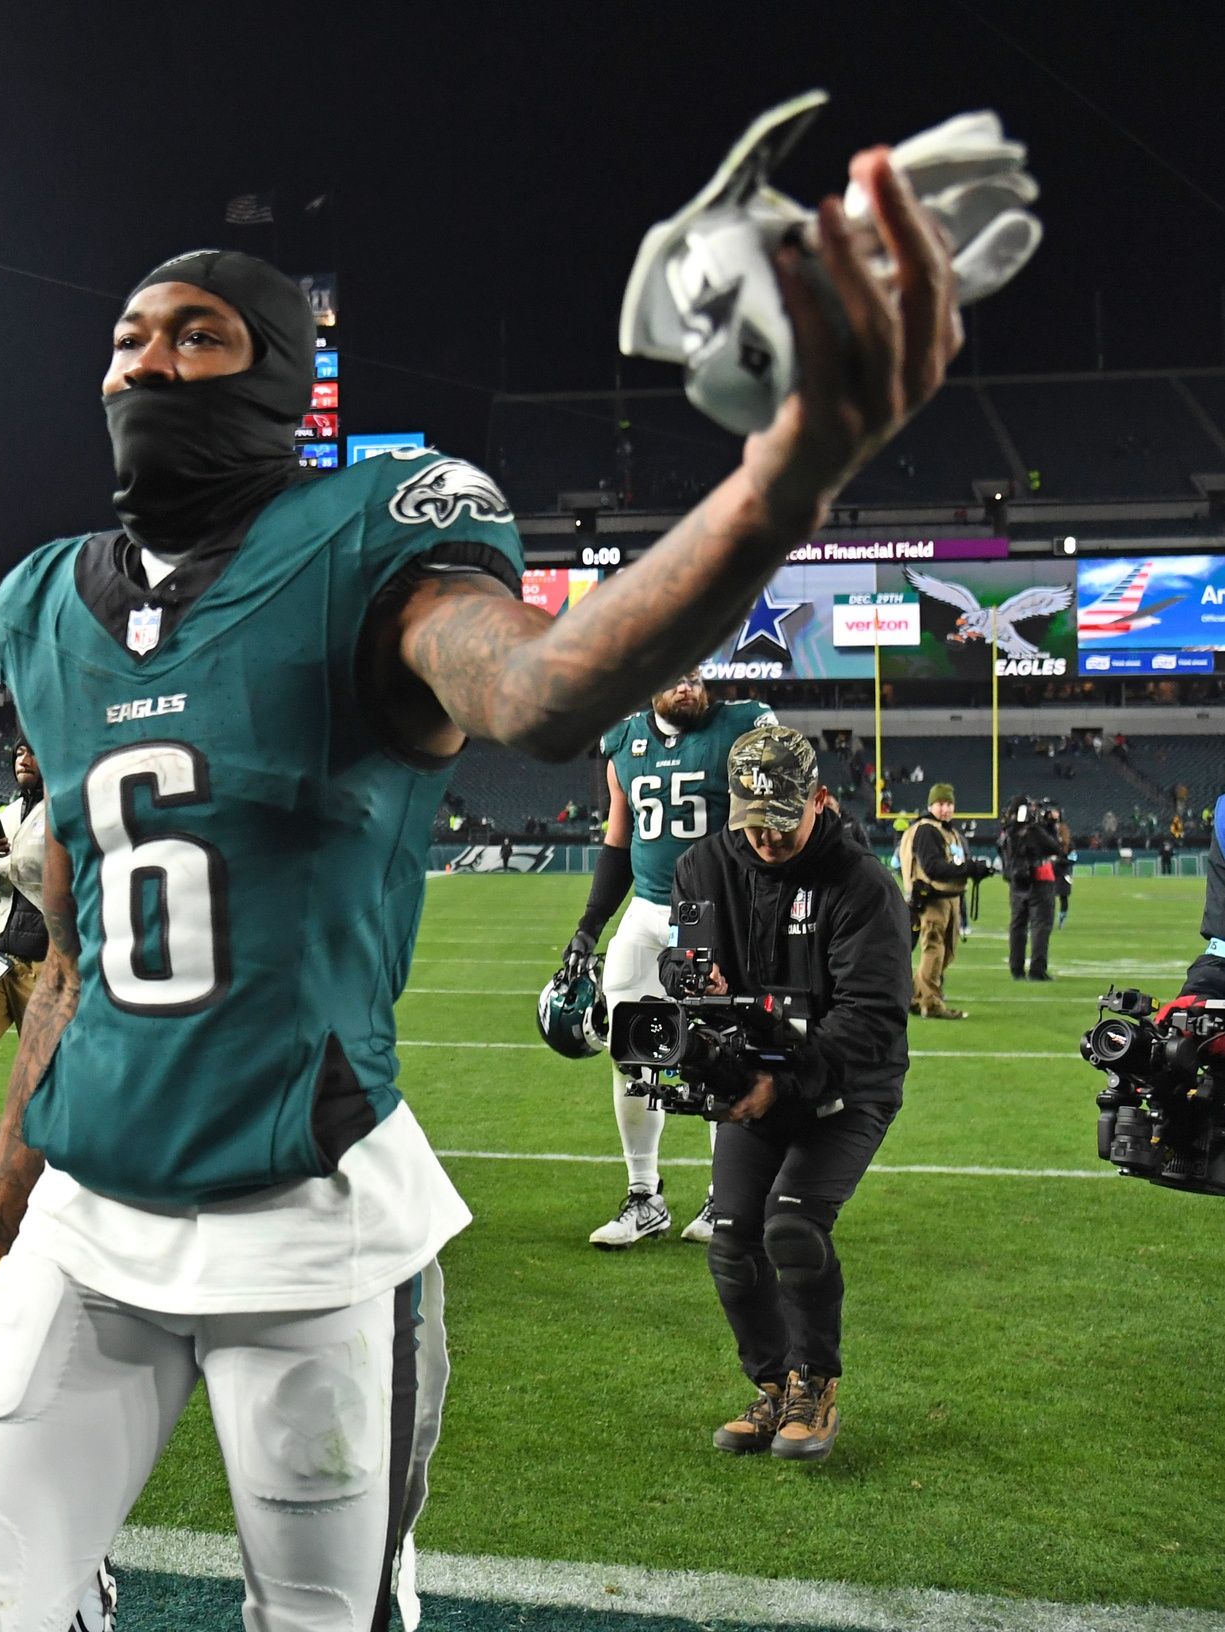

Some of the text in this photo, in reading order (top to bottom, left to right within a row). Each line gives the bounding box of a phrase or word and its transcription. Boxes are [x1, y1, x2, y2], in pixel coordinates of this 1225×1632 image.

[582, 547, 621, 565] 0:00
[786, 541, 934, 561] coln Financial Field
[845, 618, 909, 632] verzon
[699, 661, 784, 679] OWBOYS
[994, 658, 1067, 676] EAGLES
[106, 693, 188, 724] EAGLES
[632, 739, 648, 753] C
[751, 766, 774, 796] LA
[630, 770, 708, 841] 65
[84, 743, 218, 1008] 6
